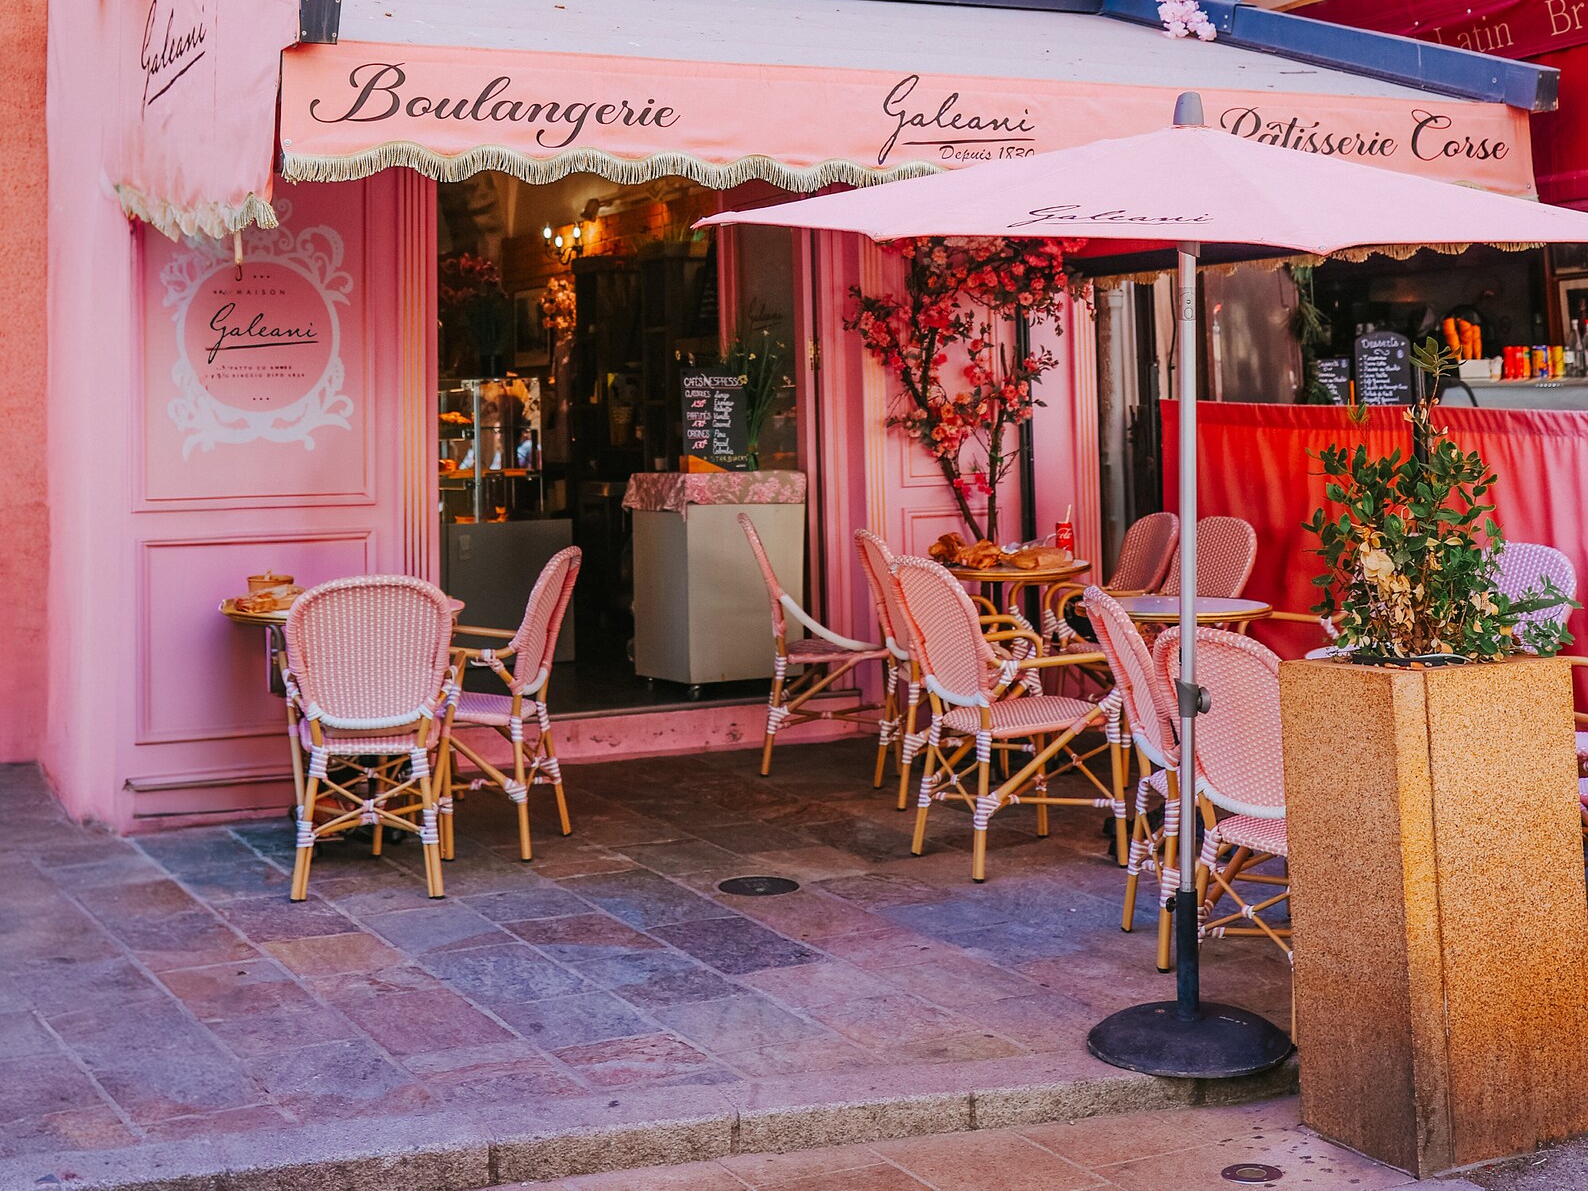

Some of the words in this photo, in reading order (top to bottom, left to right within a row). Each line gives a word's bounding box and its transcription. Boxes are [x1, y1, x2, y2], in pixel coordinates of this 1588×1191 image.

[308, 61, 681, 149] Boulangerie
[877, 74, 1035, 166] Galeani
[1219, 106, 1398, 156] Pâtisserie
[1411, 108, 1510, 161] Corse
[938, 144, 992, 163] Depuis
[1006, 204, 1214, 228] Galeani
[207, 302, 318, 365] Galeani
